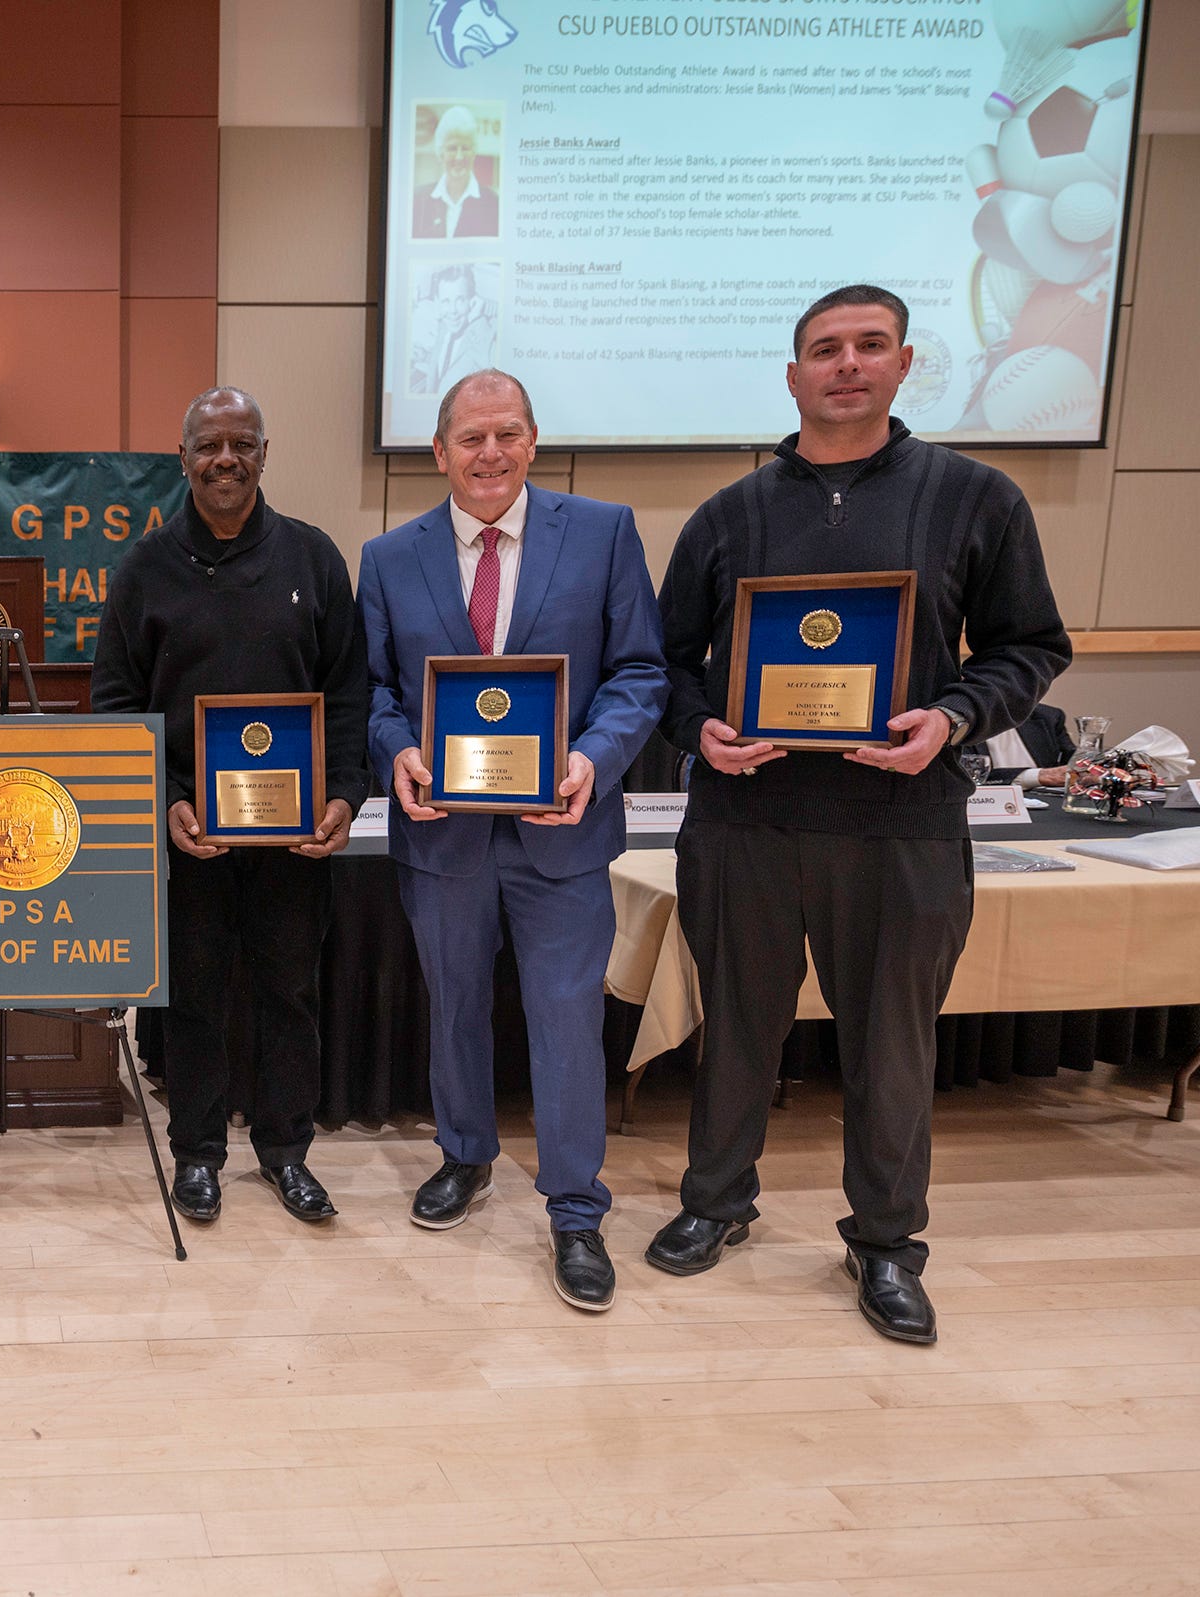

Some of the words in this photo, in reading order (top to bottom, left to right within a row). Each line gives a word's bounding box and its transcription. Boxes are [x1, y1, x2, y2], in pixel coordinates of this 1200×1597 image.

[557, 15, 596, 36] CSU
[602, 15, 678, 37] PUEBLO
[683, 16, 821, 38] OUTSTANDING
[826, 17, 906, 38] ATHLETE
[911, 18, 984, 39] AWARD
[518, 137, 550, 148] Jessie
[552, 137, 584, 148] Banks
[586, 136, 620, 148] Award
[518, 156, 539, 166] This
[542, 156, 575, 166] award
[577, 156, 586, 166] is
[588, 156, 624, 166] named
[626, 156, 650, 166] after
[653, 156, 682, 166] Jessie
[720, 158, 727, 166] a
[729, 156, 768, 169] pioneer
[770, 156, 780, 166] in
[866, 156, 896, 166] Banks
[898, 156, 945, 166] launched
[947, 156, 964, 166] the
[568, 174, 619, 184] basketball
[622, 176, 666, 186] program
[668, 174, 688, 184] and
[690, 174, 724, 184] served
[727, 176, 738, 184] as
[741, 174, 754, 184] its
[756, 174, 786, 184] coach
[788, 174, 802, 184] for
[806, 176, 834, 186] many
[869, 174, 887, 184] She
[890, 174, 910, 184] also
[913, 174, 948, 186] played
[949, 176, 962, 184] an
[0, 940, 37, 964] OF
[53, 939, 131, 964] FAME
